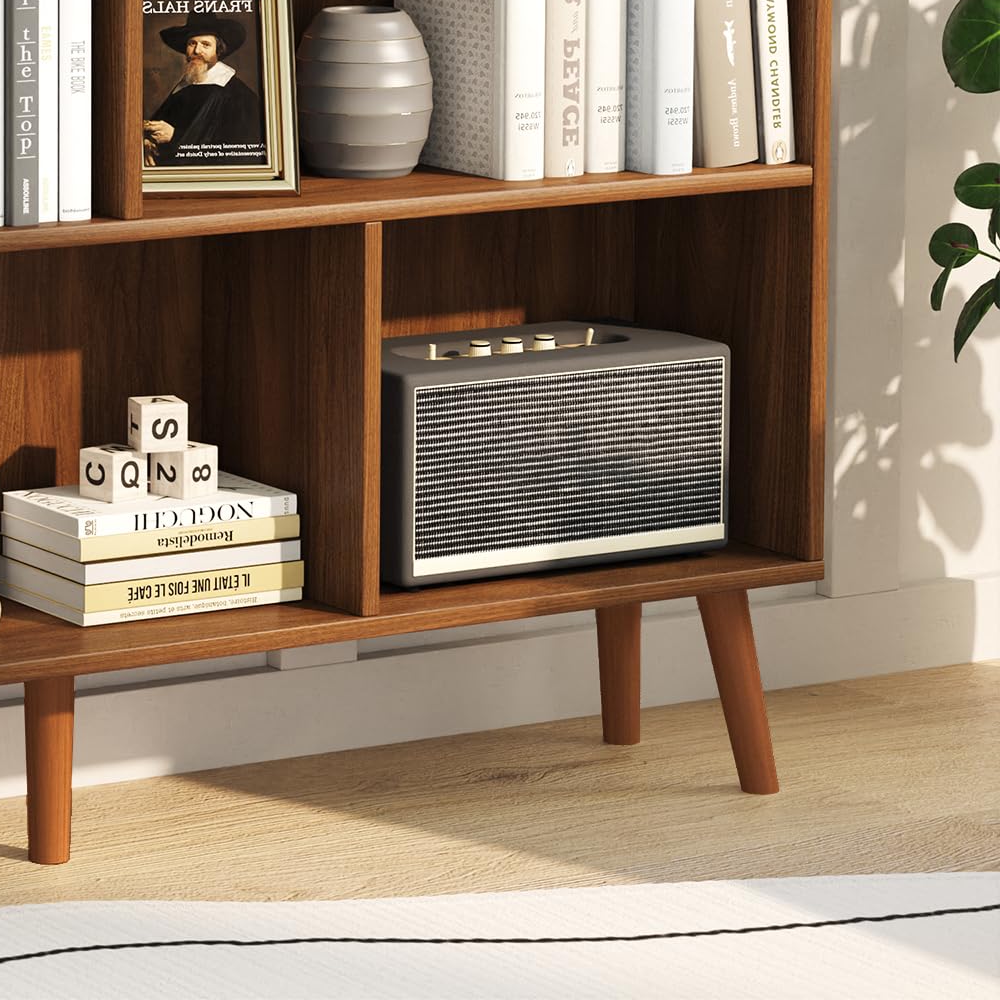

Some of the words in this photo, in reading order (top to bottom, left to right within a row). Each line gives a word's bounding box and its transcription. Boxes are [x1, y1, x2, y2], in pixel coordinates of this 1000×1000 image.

[20, 27, 34, 78] the
[41, 25, 52, 62] EAMES
[71, 40, 86, 54] THE
[71, 57, 86, 73] BIKE
[71, 76, 86, 95] BOOK
[19, 95, 35, 155] Top
[22, 177, 30, 215] ASSOULINE
[152, 418, 179, 440] S
[85, 461, 105, 486] C
[121, 460, 140, 489] Q
[157, 462, 177, 483] 2
[192, 464, 212, 483] 8
[134, 501, 254, 531] NOGUCHI
[157, 530, 234, 548] Remodelista
[168, 581, 189, 597] FOIS
[192, 578, 211, 594] UNE
[213, 575, 239, 592] ÉTAIT
[242, 573, 250, 588] IL
[128, 585, 152, 604] CAFÉ
[155, 583, 166, 598] LE
